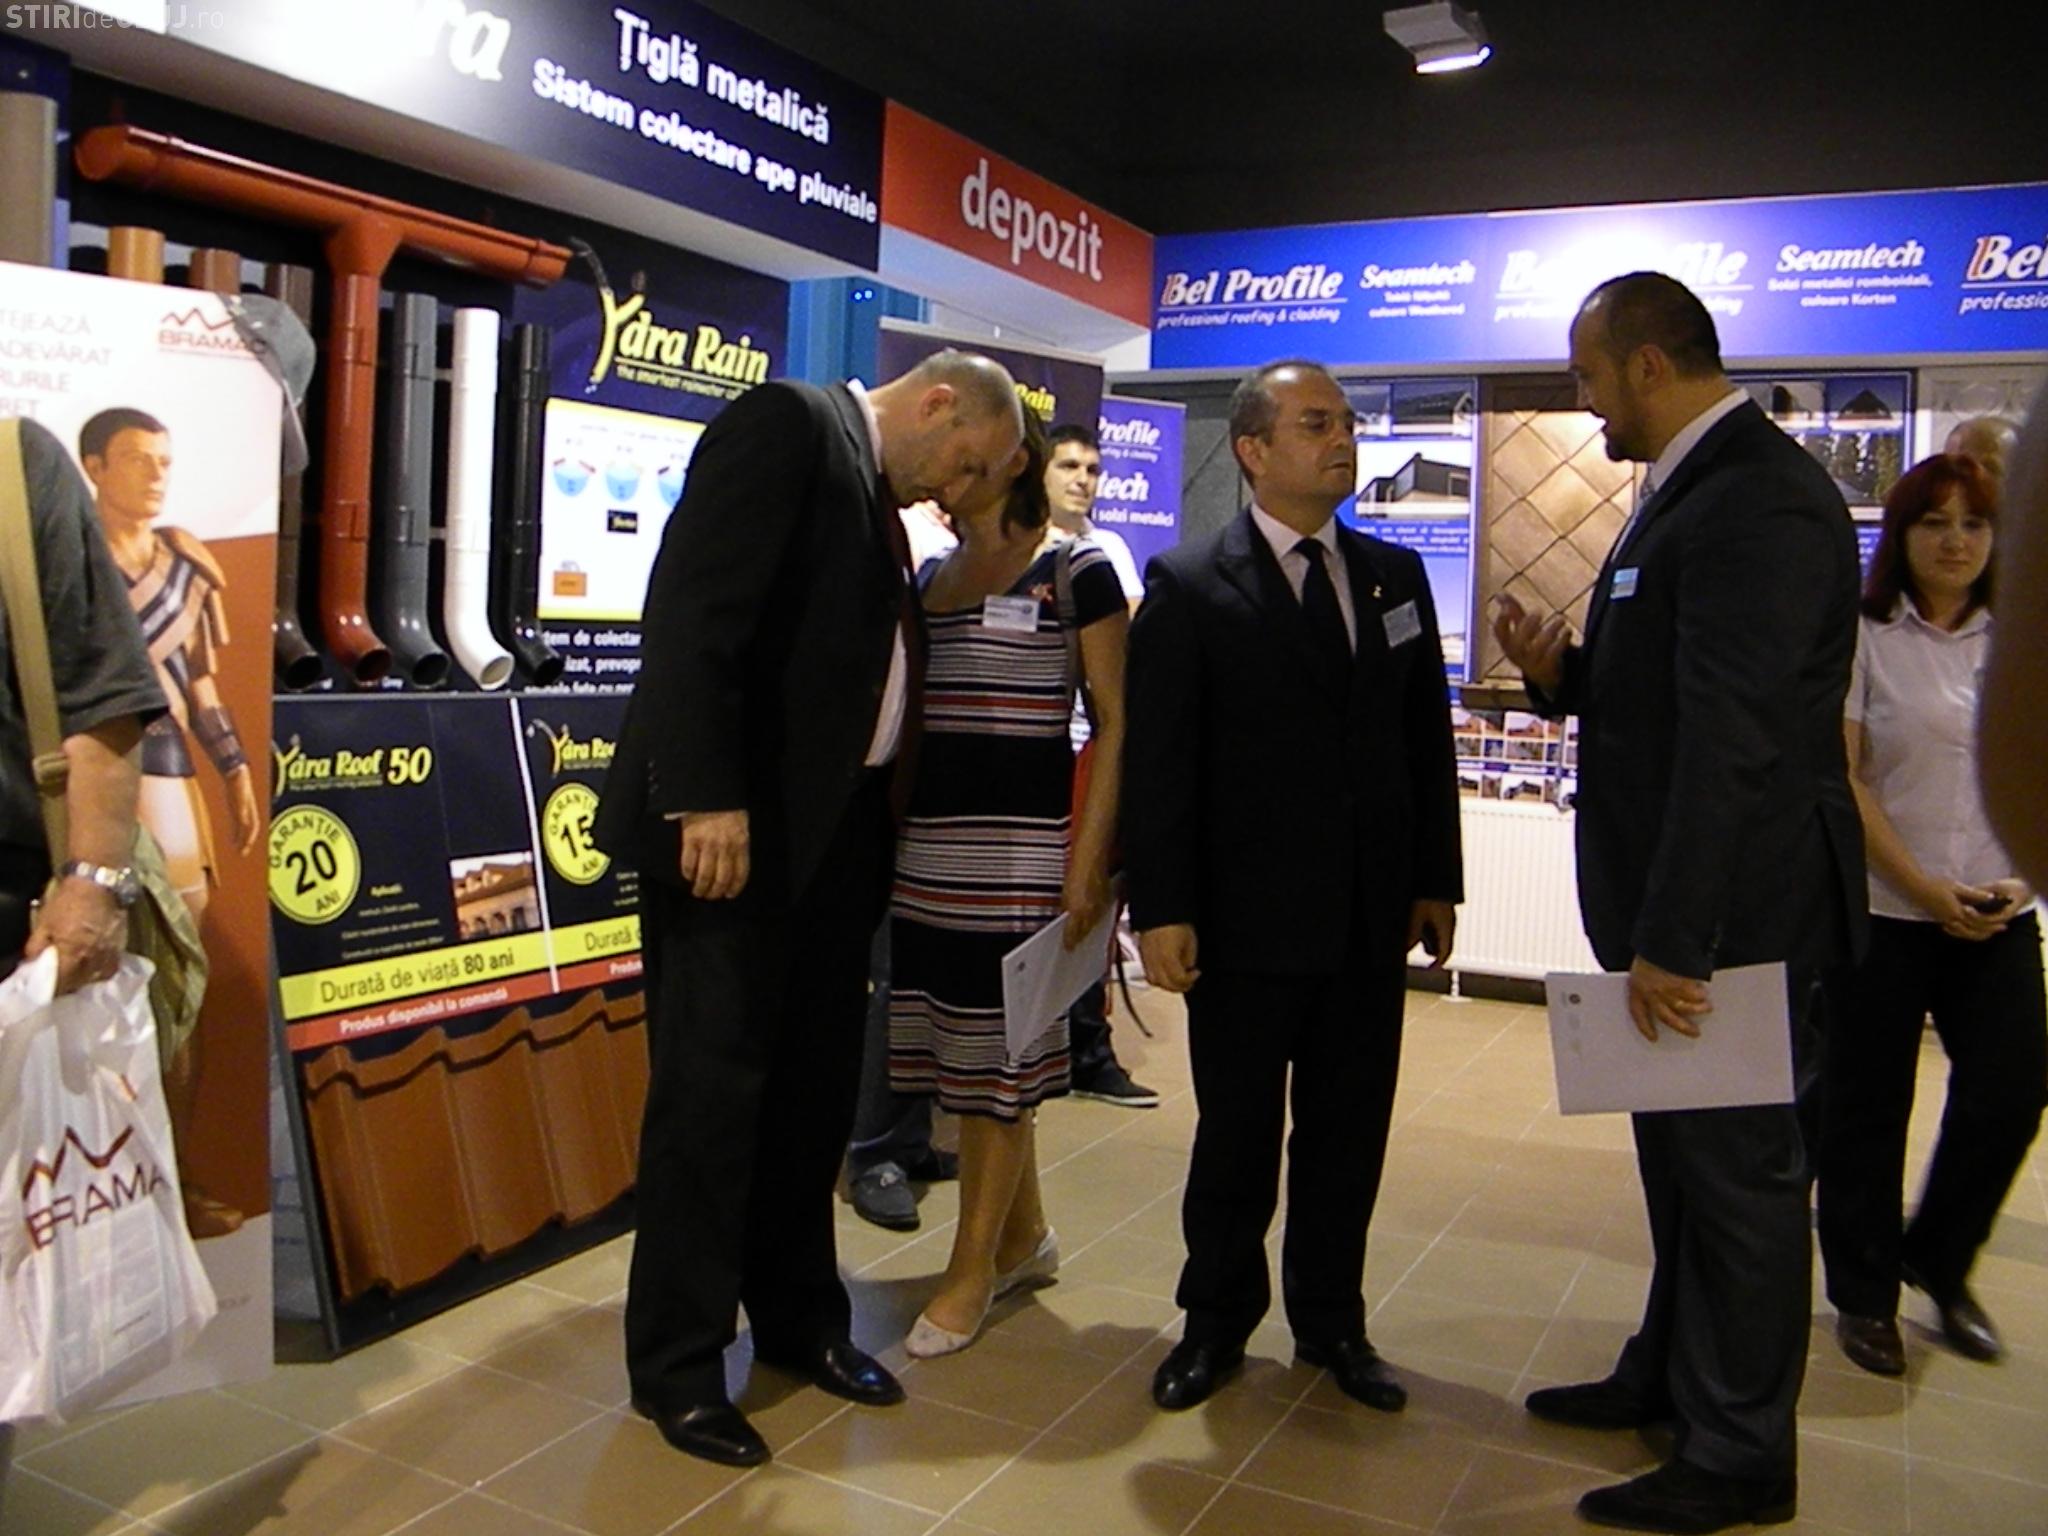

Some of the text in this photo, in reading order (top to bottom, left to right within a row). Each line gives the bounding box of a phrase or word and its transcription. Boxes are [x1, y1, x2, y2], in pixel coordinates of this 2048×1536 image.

[708, 60, 830, 145] metalică
[532, 58, 878, 225] Sistem colectare ape pluviale
[961, 157, 1103, 282] depozit
[1775, 239, 1926, 273] Seamtech
[1159, 263, 1344, 306] Bel Profile
[1360, 259, 1476, 289] Seamtech
[1801, 275, 1854, 290] metalici
[1851, 292, 1897, 305] Korten
[1157, 307, 1341, 330] professional roofing & cladding
[690, 325, 770, 385] Rain
[573, 629, 591, 646] de
[335, 748, 384, 777] Roof
[387, 745, 433, 786] 50
[285, 840, 337, 896] 20
[315, 889, 341, 913] ANI
[585, 928, 632, 952] Durată
[320, 972, 386, 1004] Durată
[390, 962, 414, 989] de
[463, 952, 486, 975] 80
[488, 947, 515, 970] ani
[339, 1014, 385, 1035] Produs
